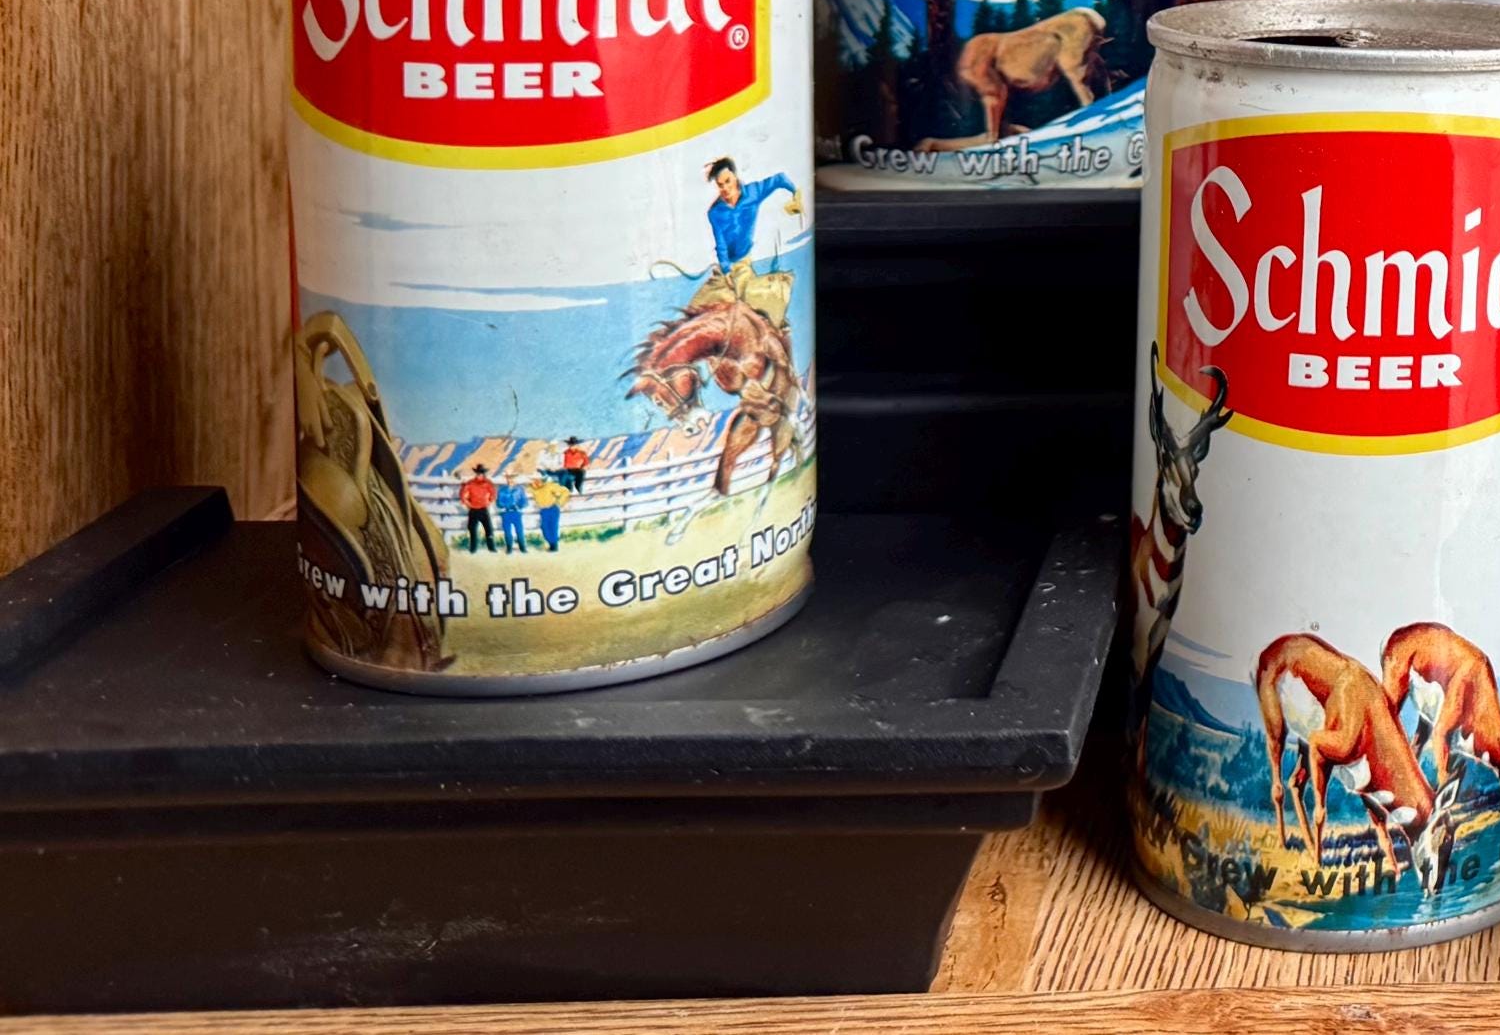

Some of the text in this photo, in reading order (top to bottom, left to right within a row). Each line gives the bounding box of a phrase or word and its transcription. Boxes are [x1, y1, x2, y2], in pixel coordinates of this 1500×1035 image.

[403, 60, 603, 99] BEER
[852, 133, 938, 175] Grew
[957, 137, 1040, 177] with
[1057, 136, 1111, 175] the
[1287, 352, 1463, 390] BEER
[360, 574, 468, 618] with
[486, 577, 580, 619] the
[598, 543, 739, 608] Great
[1300, 855, 1397, 897] with
